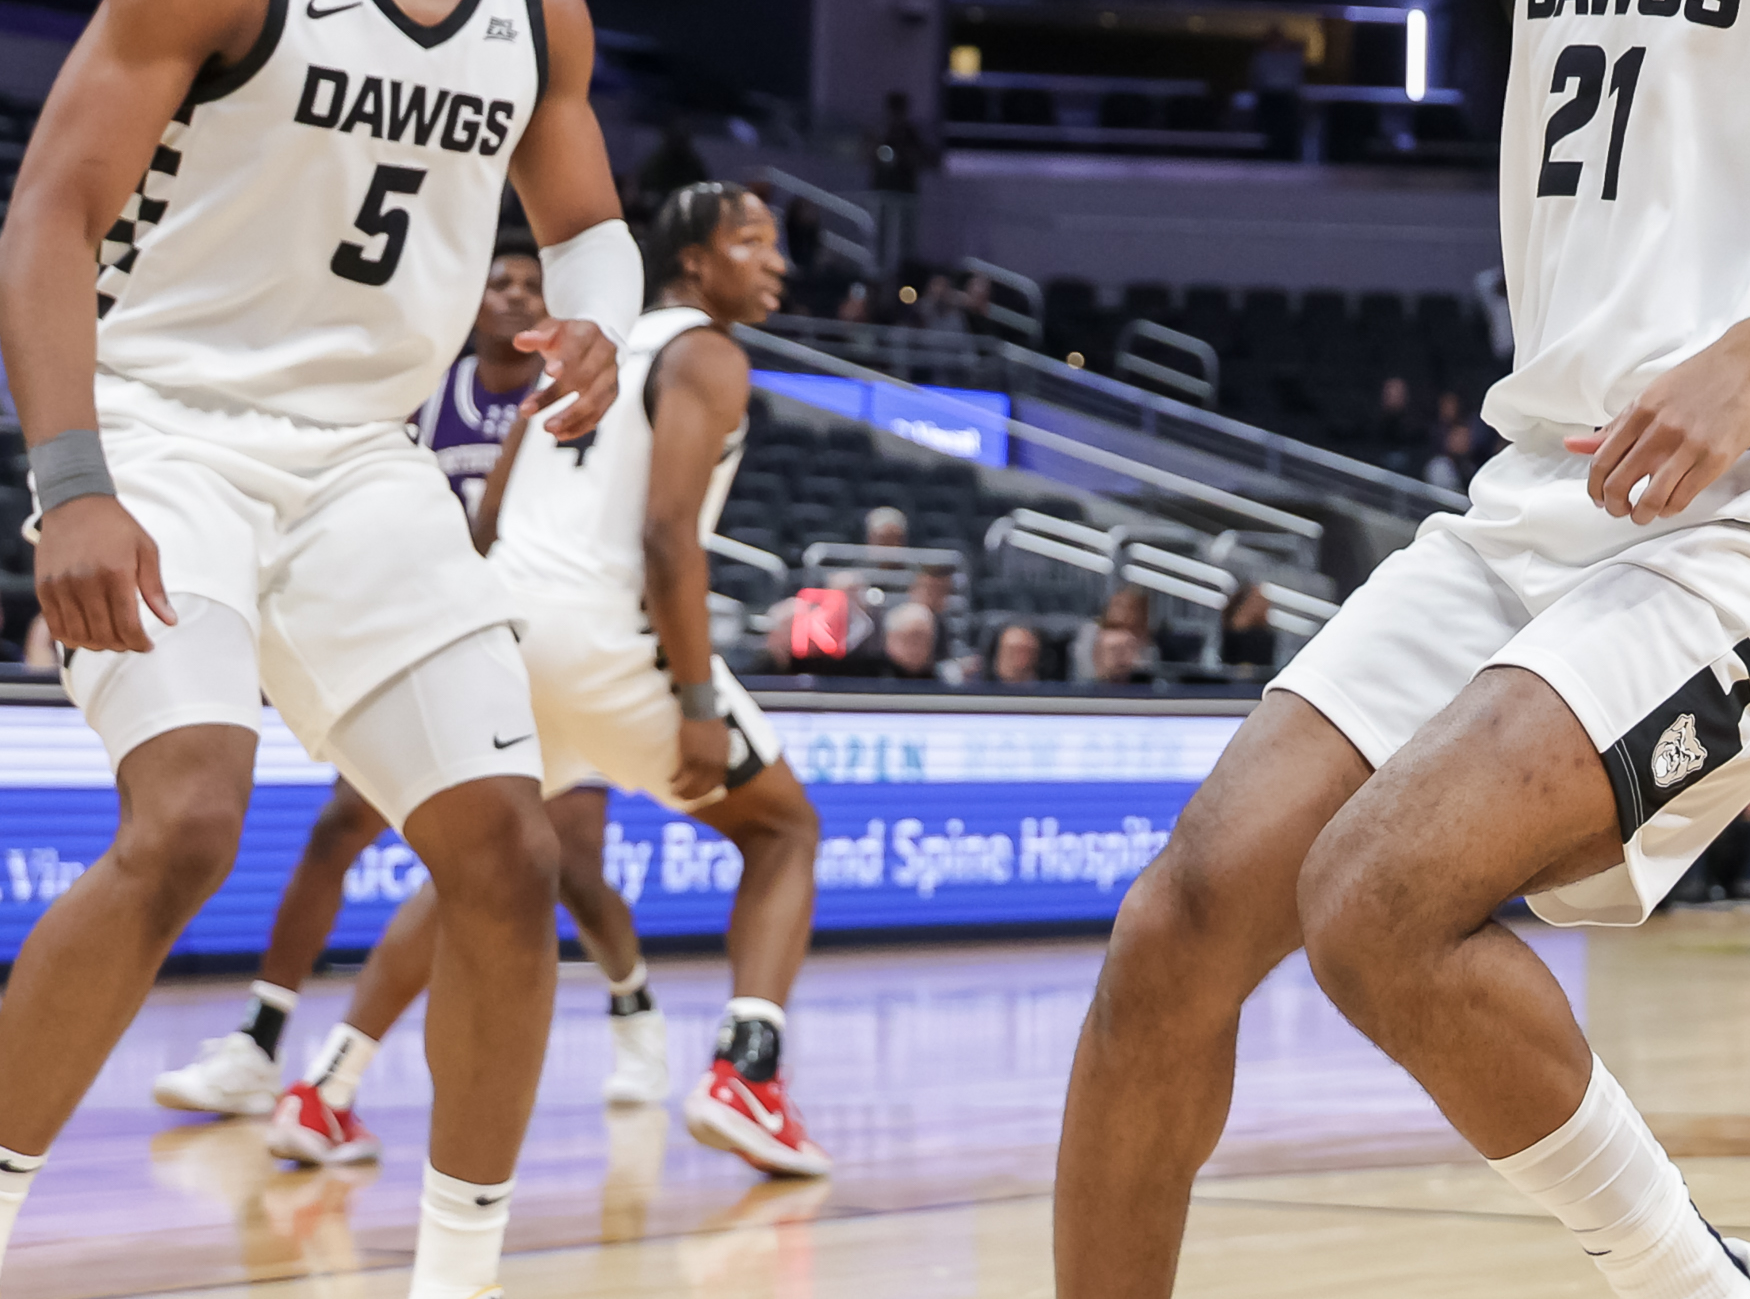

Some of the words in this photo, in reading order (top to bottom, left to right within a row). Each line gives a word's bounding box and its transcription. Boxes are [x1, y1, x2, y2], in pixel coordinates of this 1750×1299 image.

[294, 64, 515, 156] DAWGS
[1537, 45, 1647, 201] 21
[330, 163, 428, 286] 5
[660, 822, 745, 894] Bra
[893, 817, 1014, 898] Spine
